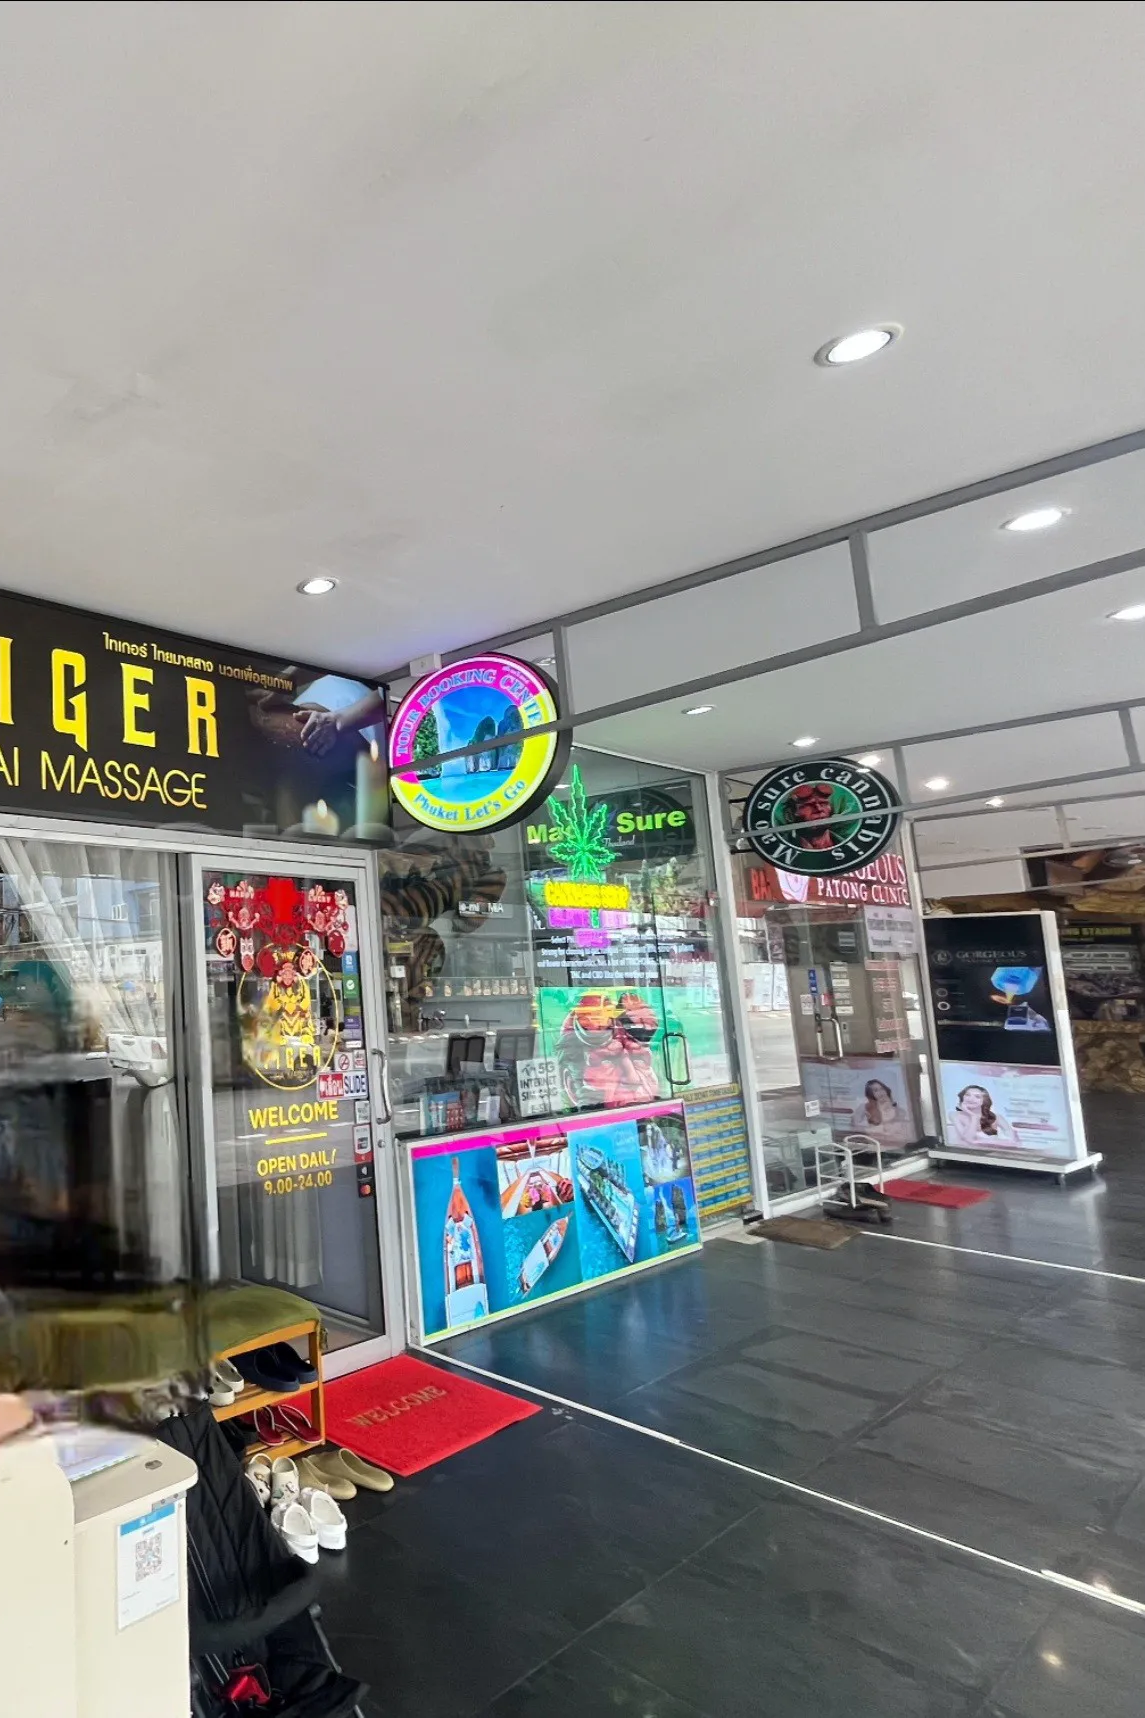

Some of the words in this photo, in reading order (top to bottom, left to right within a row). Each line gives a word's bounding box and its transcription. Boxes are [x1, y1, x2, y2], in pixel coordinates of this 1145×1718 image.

[396, 709, 422, 758] TOUR
[417, 668, 498, 708] BOOKING
[499, 675, 544, 727] CENTE
[40, 749, 208, 810] MASSAGE
[414, 793, 460, 821] Phuket
[464, 799, 502, 821] Let's
[503, 780, 527, 801] Go
[757, 769, 806, 812] sure
[819, 767, 883, 862] cannabis
[616, 810, 686, 834] Sure
[817, 877, 868, 902] PATONG
[871, 884, 911, 906] CLINIC
[344, 1074, 367, 1095] SLIDE
[248, 1100, 339, 1130] WELCOME
[257, 1155, 296, 1177] OPEN
[264, 1170, 333, 1195] 9.00-24.00
[345, 1386, 447, 1428] WELCOME
